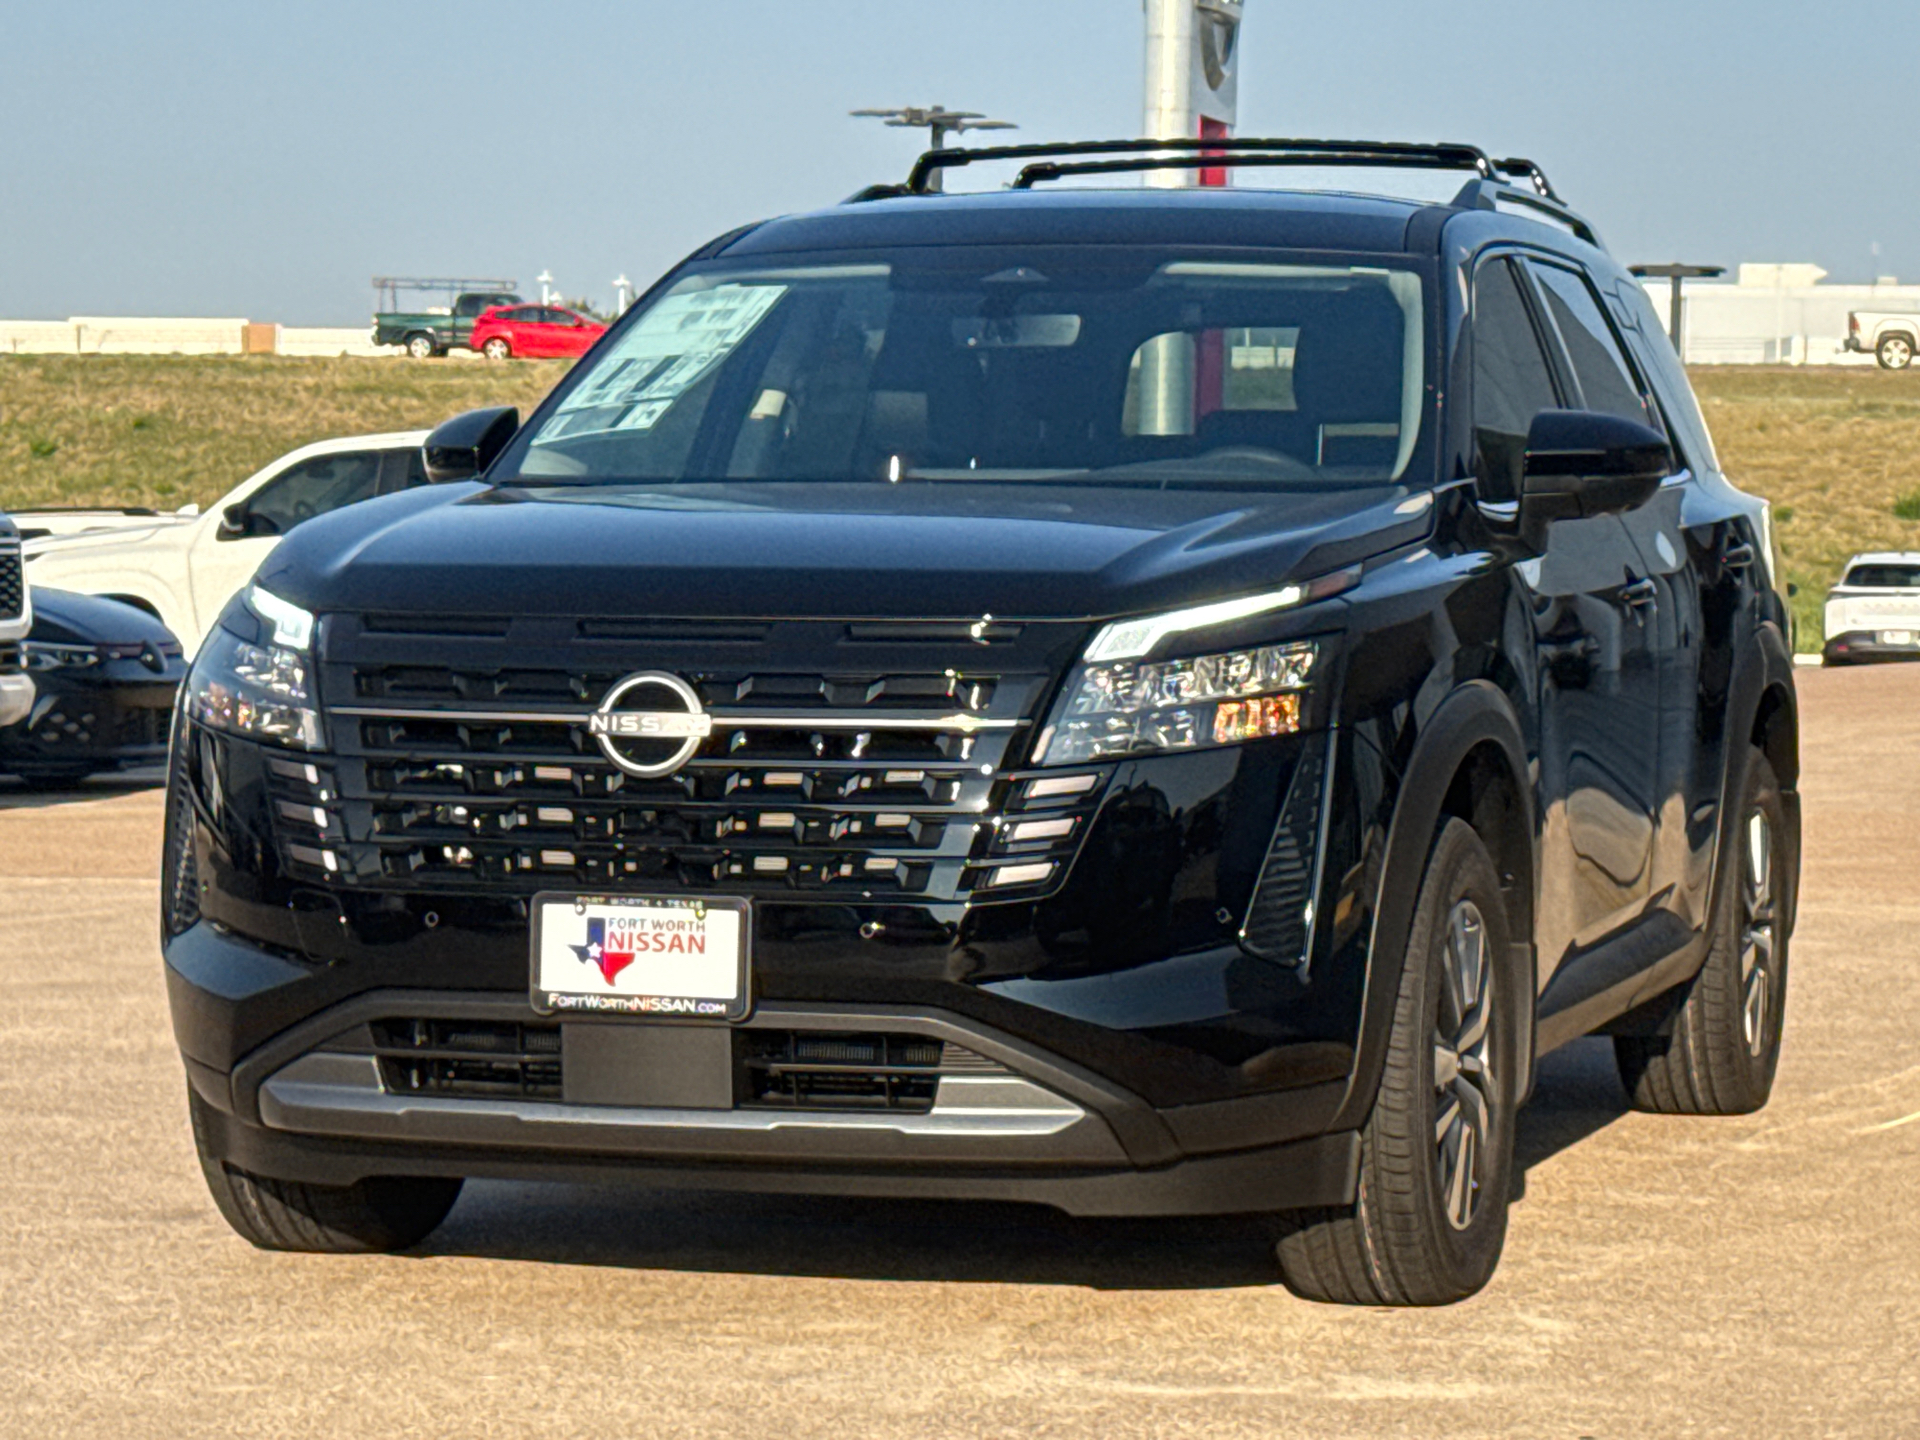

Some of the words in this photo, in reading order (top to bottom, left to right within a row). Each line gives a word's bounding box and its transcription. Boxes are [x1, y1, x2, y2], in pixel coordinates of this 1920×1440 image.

[590, 714, 710, 733] NISS
[608, 917, 647, 930] FORT
[651, 919, 705, 932] WORTH
[608, 931, 705, 954] NISSAN
